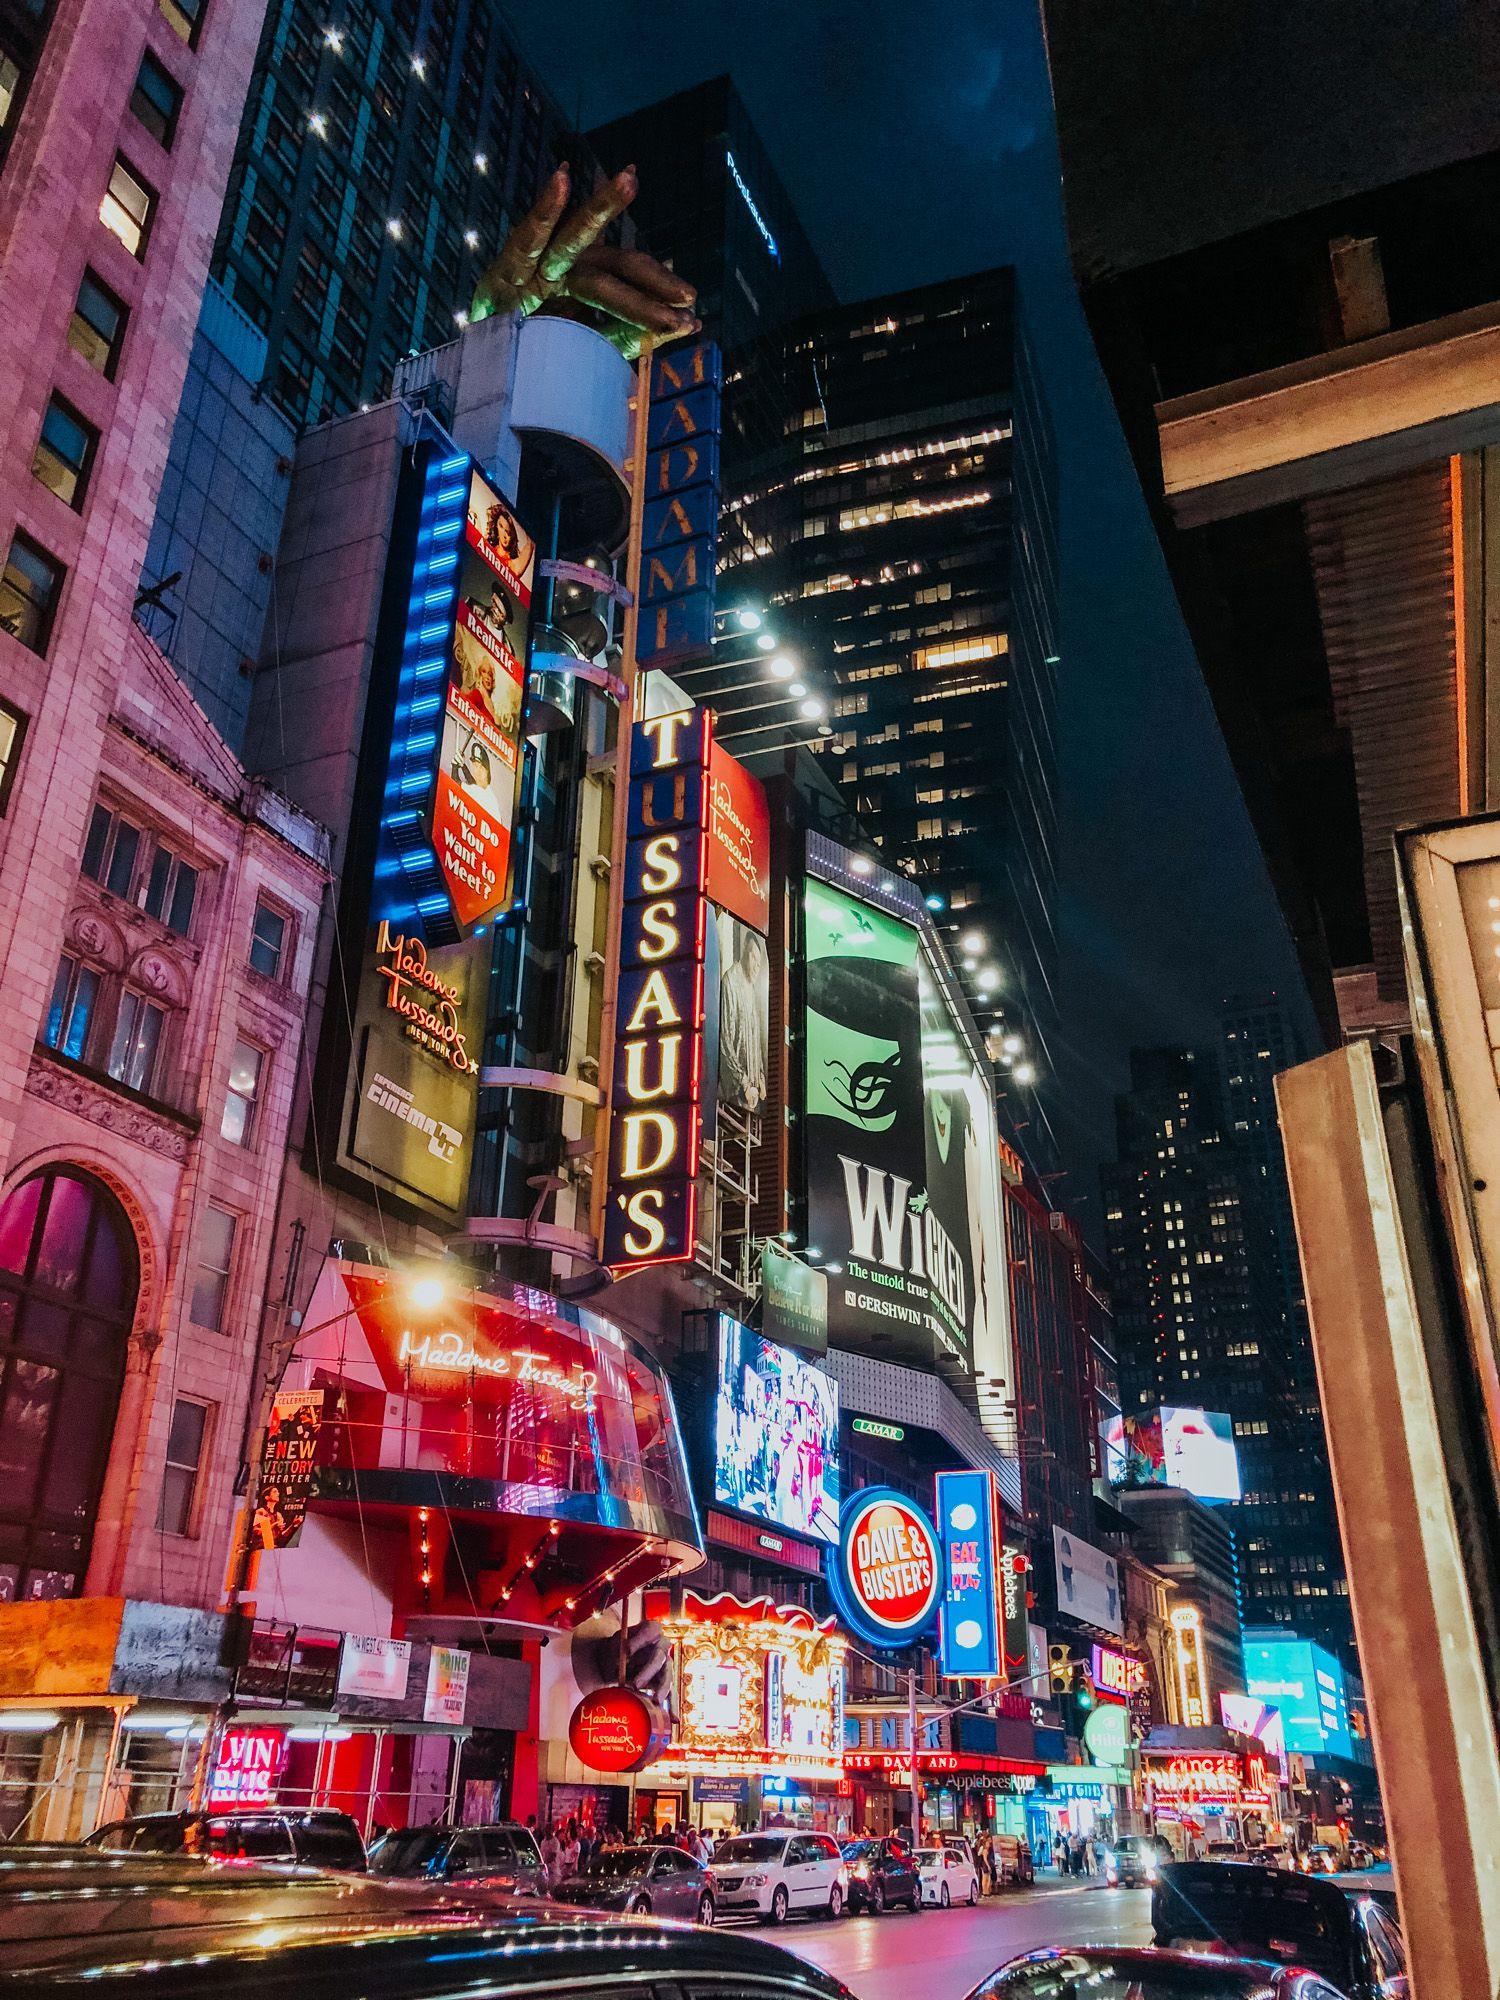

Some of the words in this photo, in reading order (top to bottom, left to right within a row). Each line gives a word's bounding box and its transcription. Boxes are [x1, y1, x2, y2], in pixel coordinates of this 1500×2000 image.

[648, 346, 705, 649] MADAME
[476, 537, 521, 597] Amazing
[467, 612, 514, 673] Realistic
[450, 686, 514, 763] Entertaining
[448, 789, 477, 827] Who
[480, 819, 499, 847] Do
[461, 821, 485, 855] You
[444, 826, 478, 870] Want
[481, 861, 496, 884] to
[444, 850, 492, 900] Meet?
[376, 920, 462, 1006] Madame
[617, 710, 691, 1257] TUSSAUD'S
[376, 965, 468, 1070] Tussauds
[408, 1024, 428, 1044] NEW
[430, 1041, 451, 1059] YORK
[366, 1083, 438, 1137] CINEMA
[847, 1261, 869, 1280] The
[871, 1270, 905, 1291] untold
[907, 1281, 929, 1299] true
[858, 1294, 921, 1326] GERSHWIN
[399, 1331, 509, 1374] Madame
[265, 1442, 275, 1459] THE
[275, 1440, 317, 1459] NEW
[860, 1421, 897, 1439] LAMAR
[262, 1474, 311, 1484] THEATER
[263, 1460, 314, 1474] VICTORY
[857, 1525, 911, 1570] DAVE
[908, 1526, 928, 1558] &
[860, 1559, 931, 1601] BUSTER'S
[1000, 1544, 1018, 1620] Applebee's
[580, 1705, 629, 1726] Madame
[581, 1725, 635, 1753] Tussauds
[929, 1757, 958, 1769] AND
[945, 1774, 1011, 1792] Applebee's
